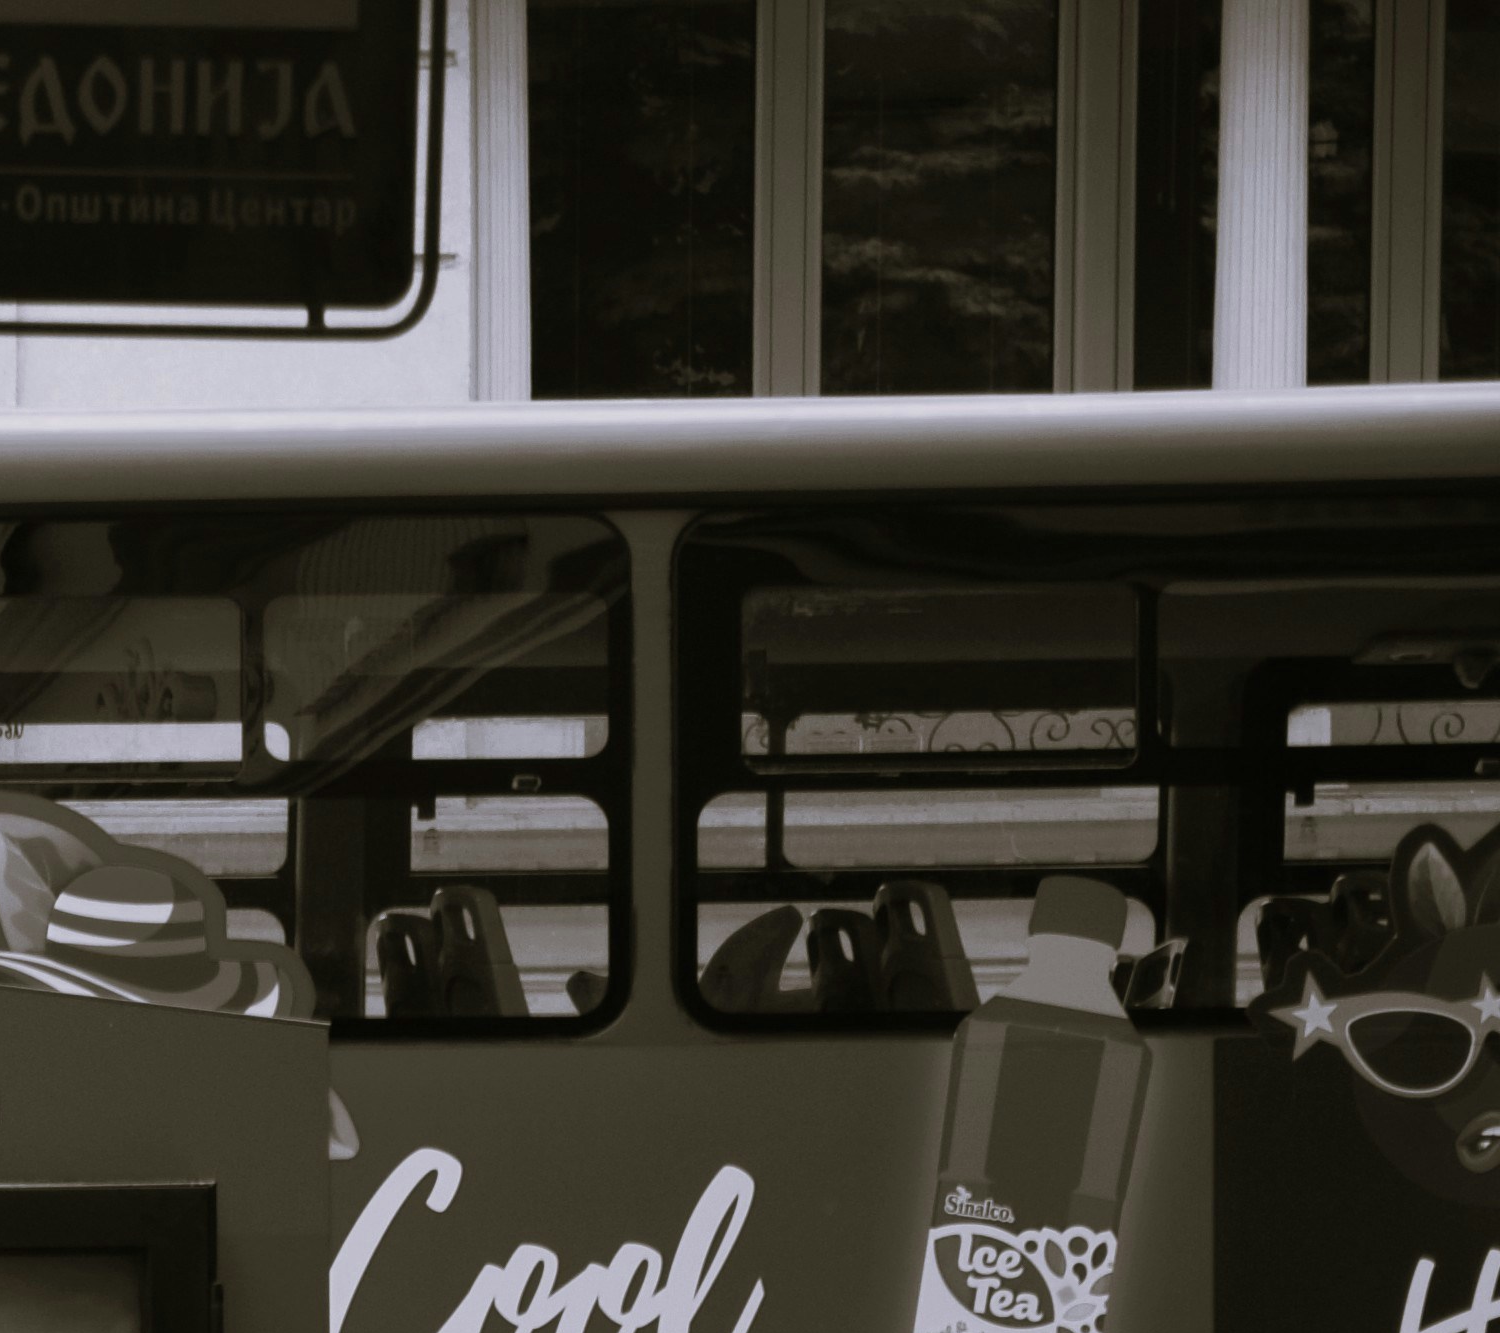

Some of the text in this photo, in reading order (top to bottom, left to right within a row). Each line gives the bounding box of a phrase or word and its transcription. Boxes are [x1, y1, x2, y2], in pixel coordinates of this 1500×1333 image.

[16, 183, 199, 227] Општина
[208, 192, 358, 235] Центар
[957, 1233, 1025, 1279] Ice
[966, 1274, 1044, 1323] Tea
